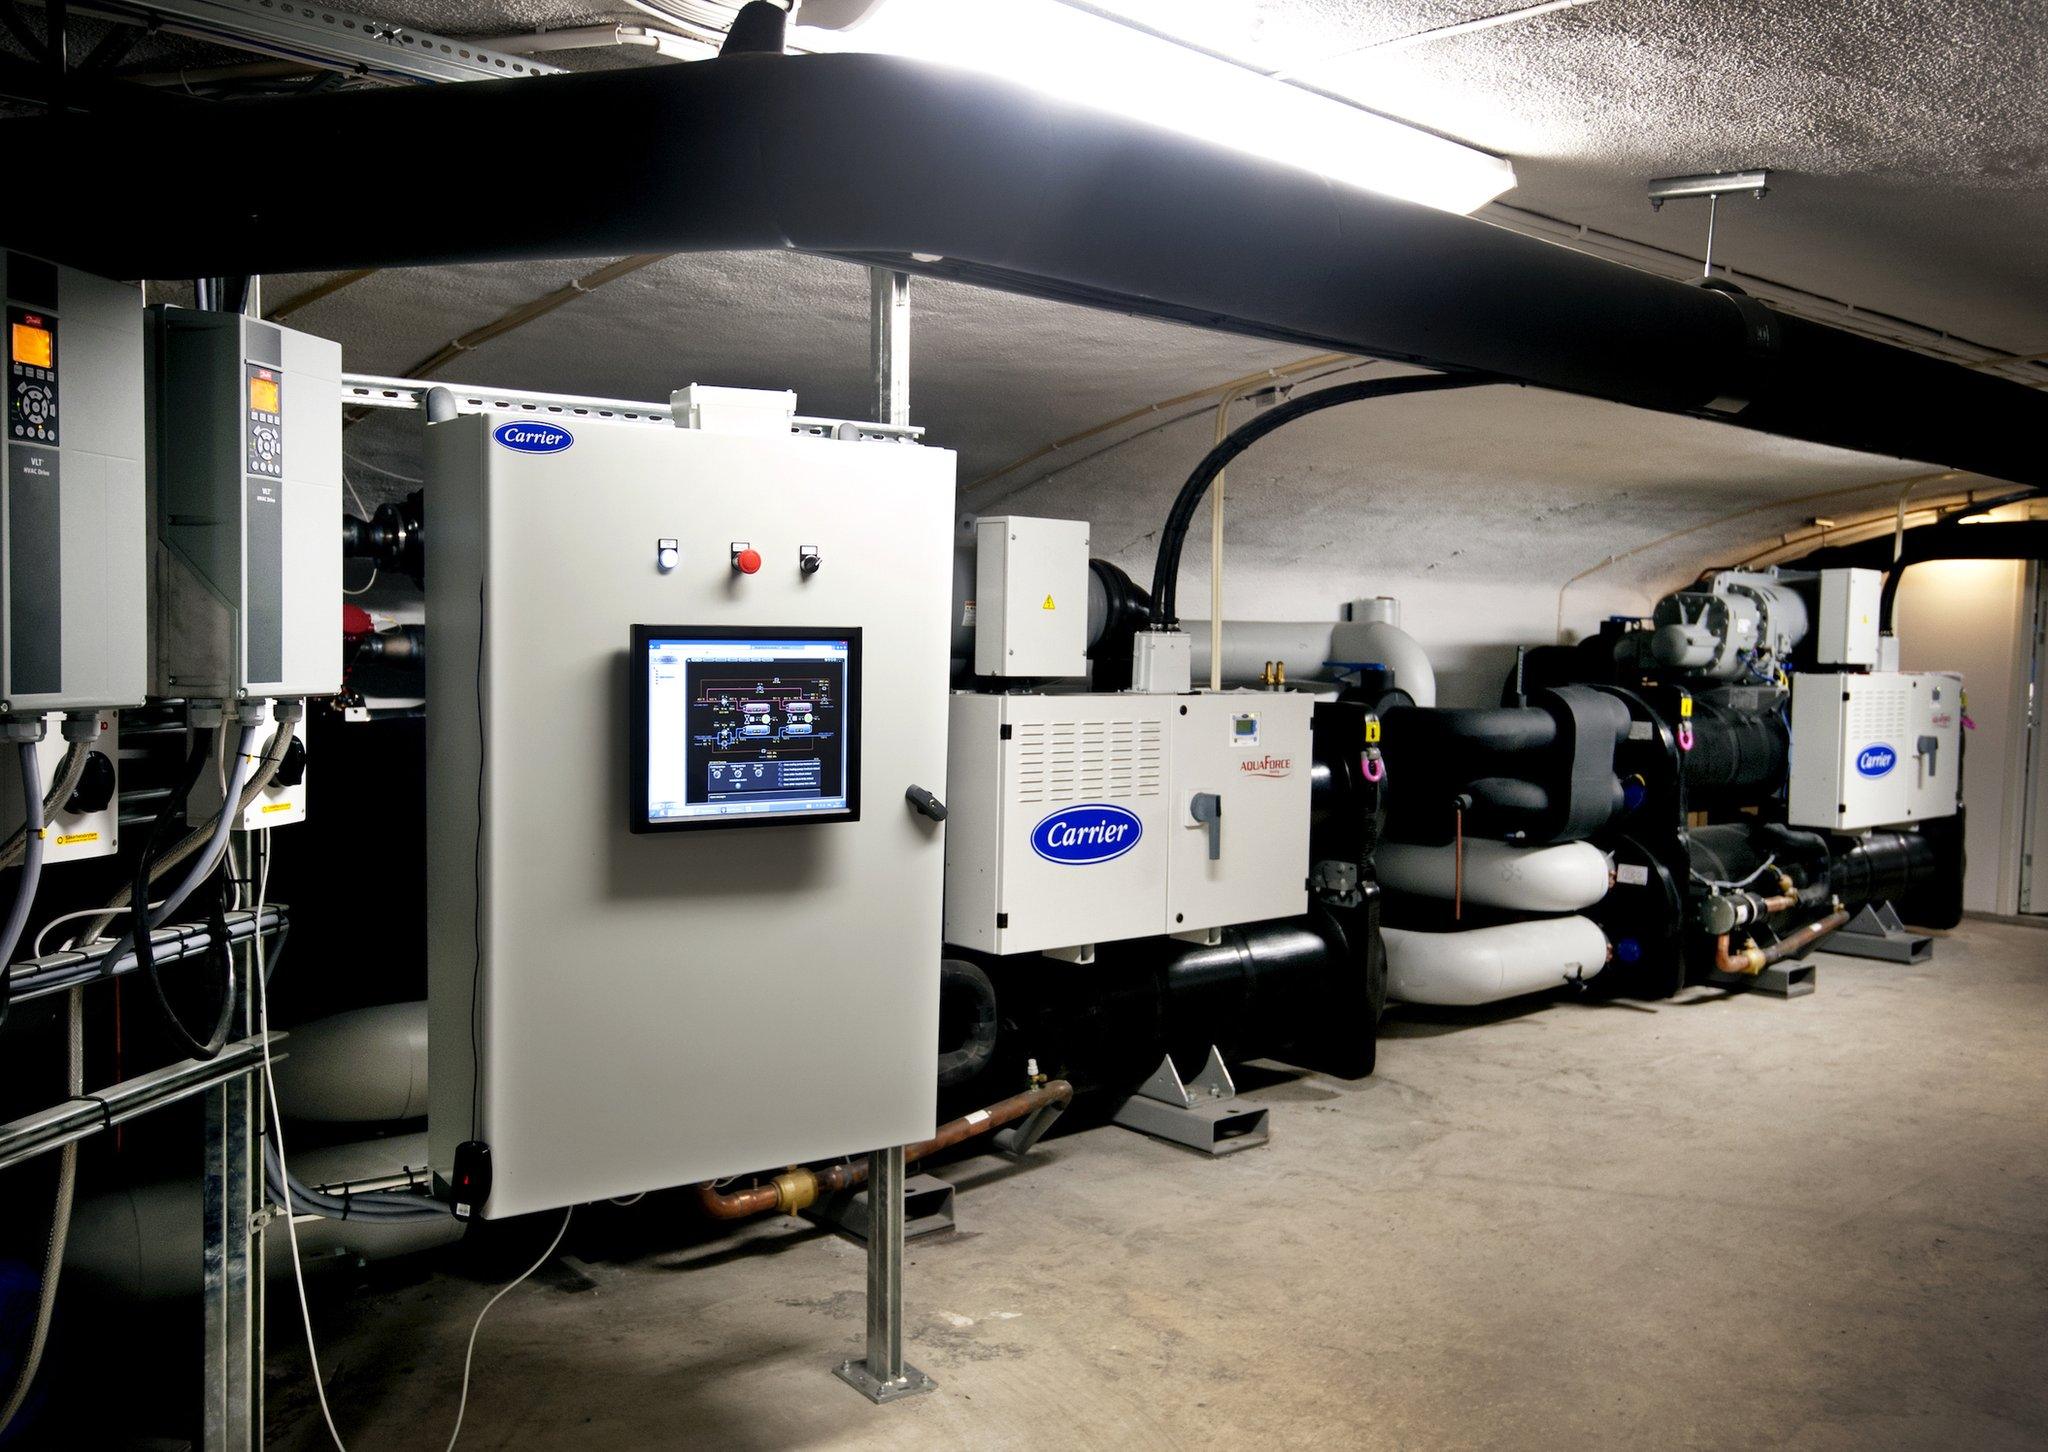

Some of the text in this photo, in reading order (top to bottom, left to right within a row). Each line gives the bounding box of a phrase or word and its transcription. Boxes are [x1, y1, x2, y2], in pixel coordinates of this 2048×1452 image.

[504, 428, 563, 445] Carrier
[1860, 751, 1892, 769] Carrier
[1047, 819, 1128, 848] Carrier
